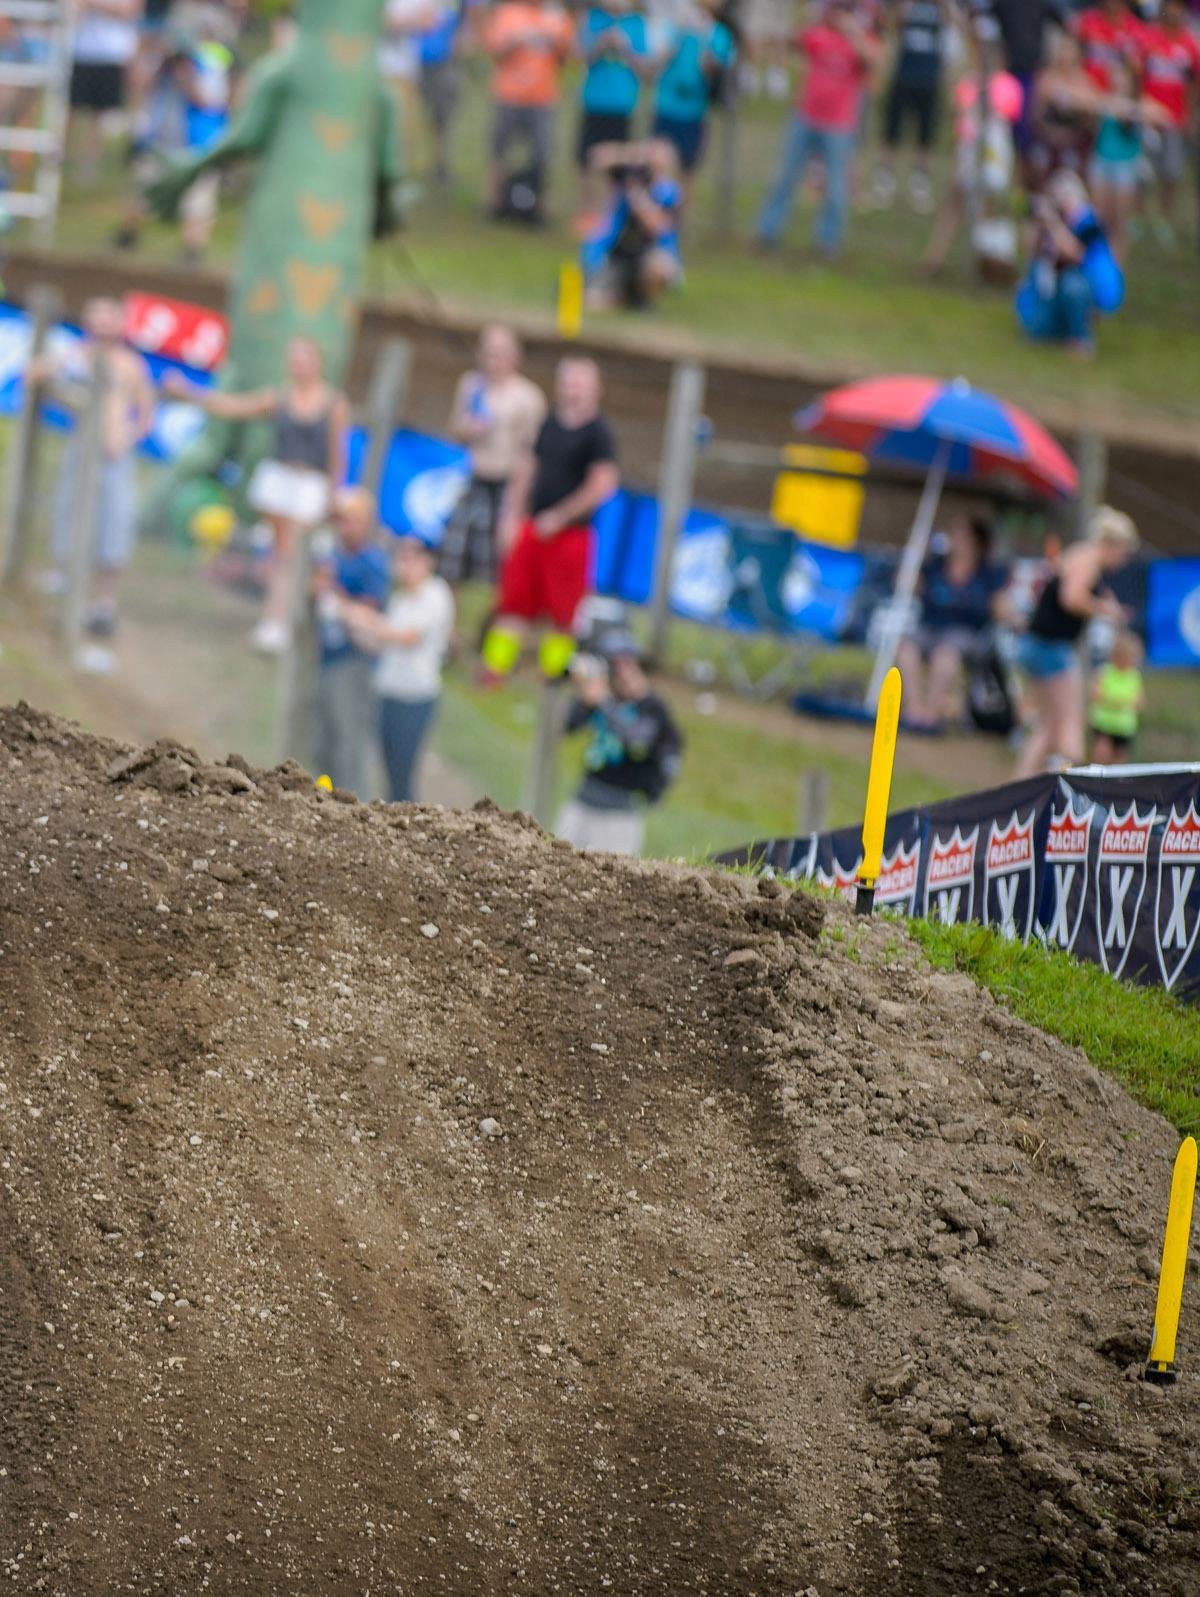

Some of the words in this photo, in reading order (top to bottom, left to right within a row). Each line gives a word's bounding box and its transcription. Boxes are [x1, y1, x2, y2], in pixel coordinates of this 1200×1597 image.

[989, 838, 1029, 866] RACER
[1047, 829, 1086, 851] RACER
[1103, 829, 1146, 851] RACER
[1165, 829, 1200, 851] RACE
[932, 853, 971, 878] RACER
[1047, 864, 1076, 948] X
[1104, 865, 1135, 949] X
[1162, 866, 1196, 949] X
